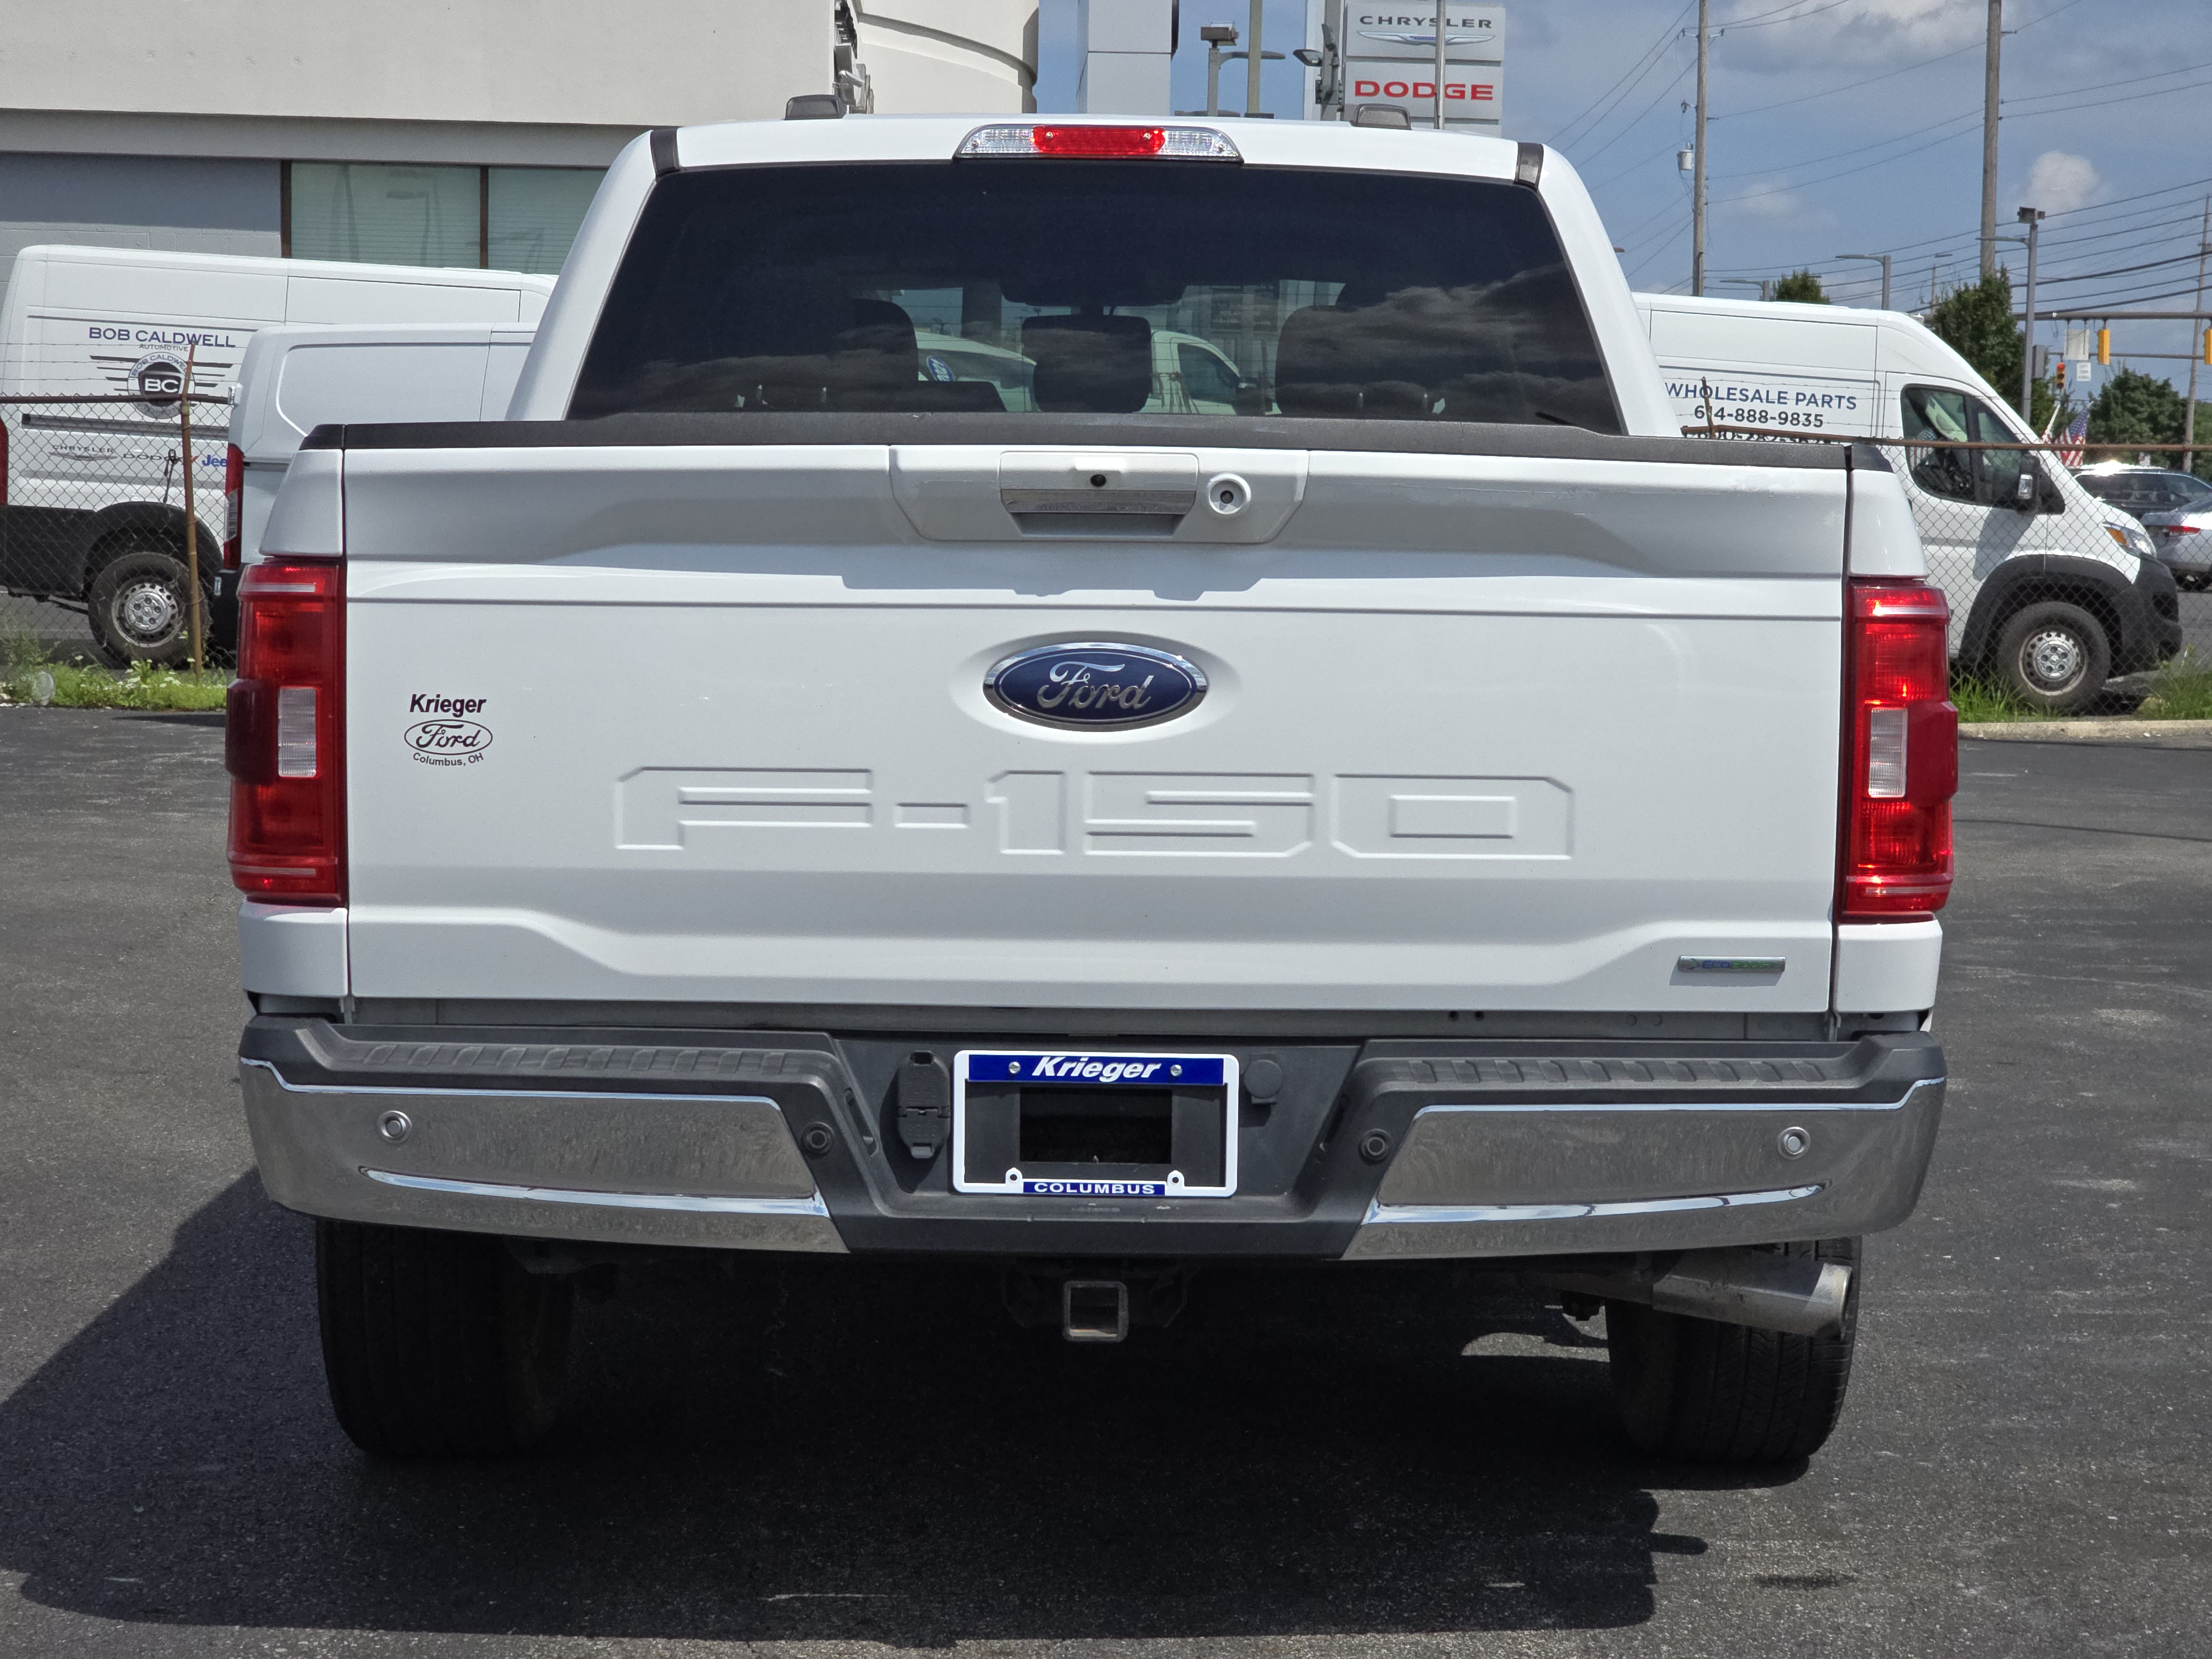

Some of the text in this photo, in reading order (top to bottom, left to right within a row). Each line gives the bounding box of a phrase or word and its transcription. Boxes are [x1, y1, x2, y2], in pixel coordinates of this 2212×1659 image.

[1359, 15, 1493, 28] CHRYSLER
[1355, 80, 1494, 101] DODGE
[89, 327, 236, 348] BOB CALDWELL
[139, 343, 189, 352] AUTOMOTIVE
[145, 378, 179, 393] BC
[1665, 382, 1857, 410] WHOLESALE PARTS
[53, 445, 114, 454] CHRYSLER
[201, 454, 228, 467] Jee
[1037, 661, 1155, 709] Ford
[409, 693, 487, 718] Krieger
[415, 723, 482, 748] Ford
[413, 753, 484, 766] Columbus, OH
[614, 766, 1573, 859] F-150
[1031, 1056, 1162, 1082] Krieger
[1034, 1182, 1155, 1194] COLUMBUS
